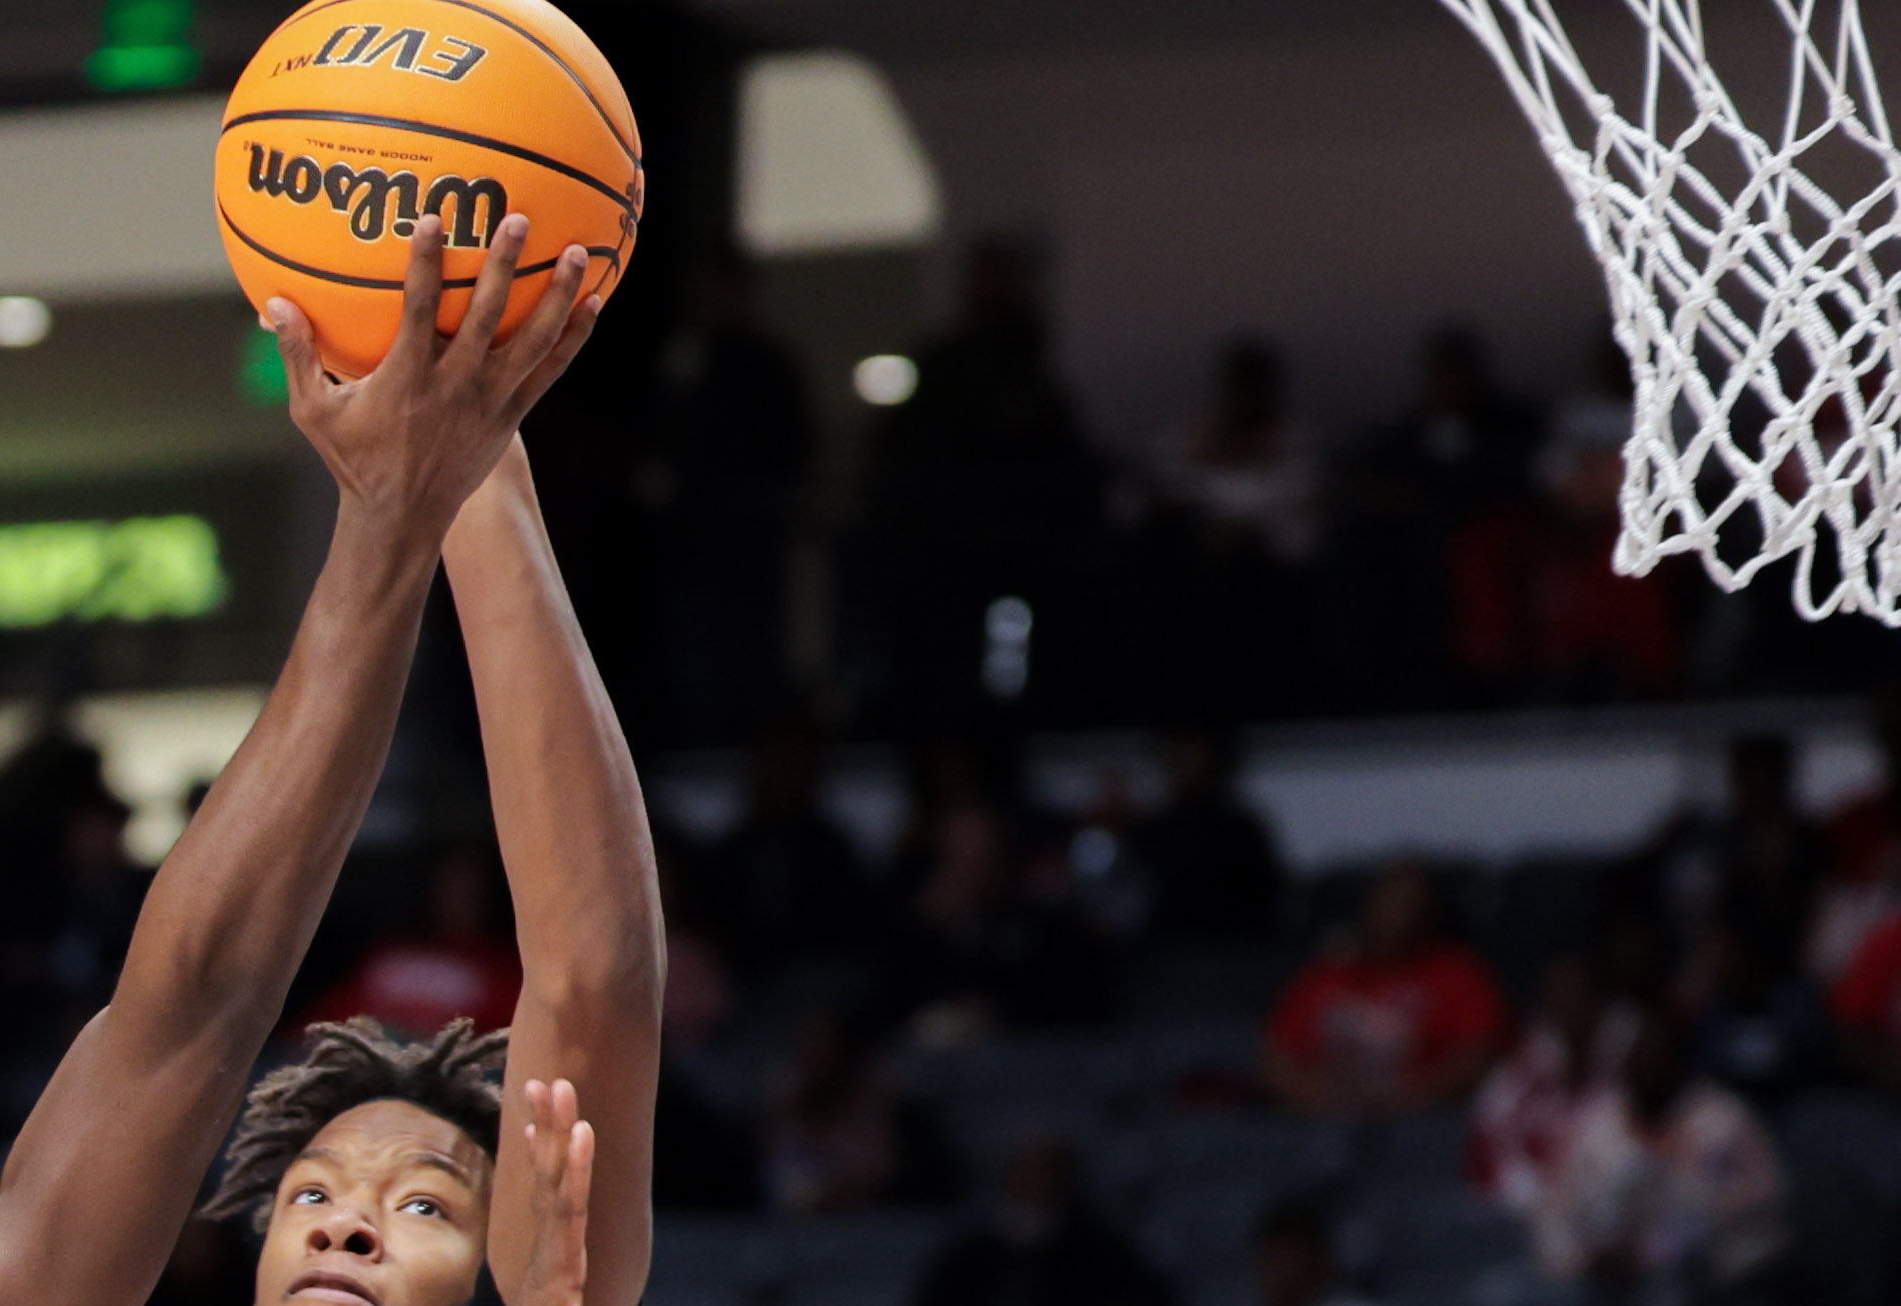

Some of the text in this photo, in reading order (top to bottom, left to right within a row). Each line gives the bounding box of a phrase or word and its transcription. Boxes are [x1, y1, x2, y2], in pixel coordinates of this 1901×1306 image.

[270, 23, 489, 83] EVO NXT
[305, 137, 433, 163] INDOOR GAME BALL
[248, 143, 508, 250] Wilson
